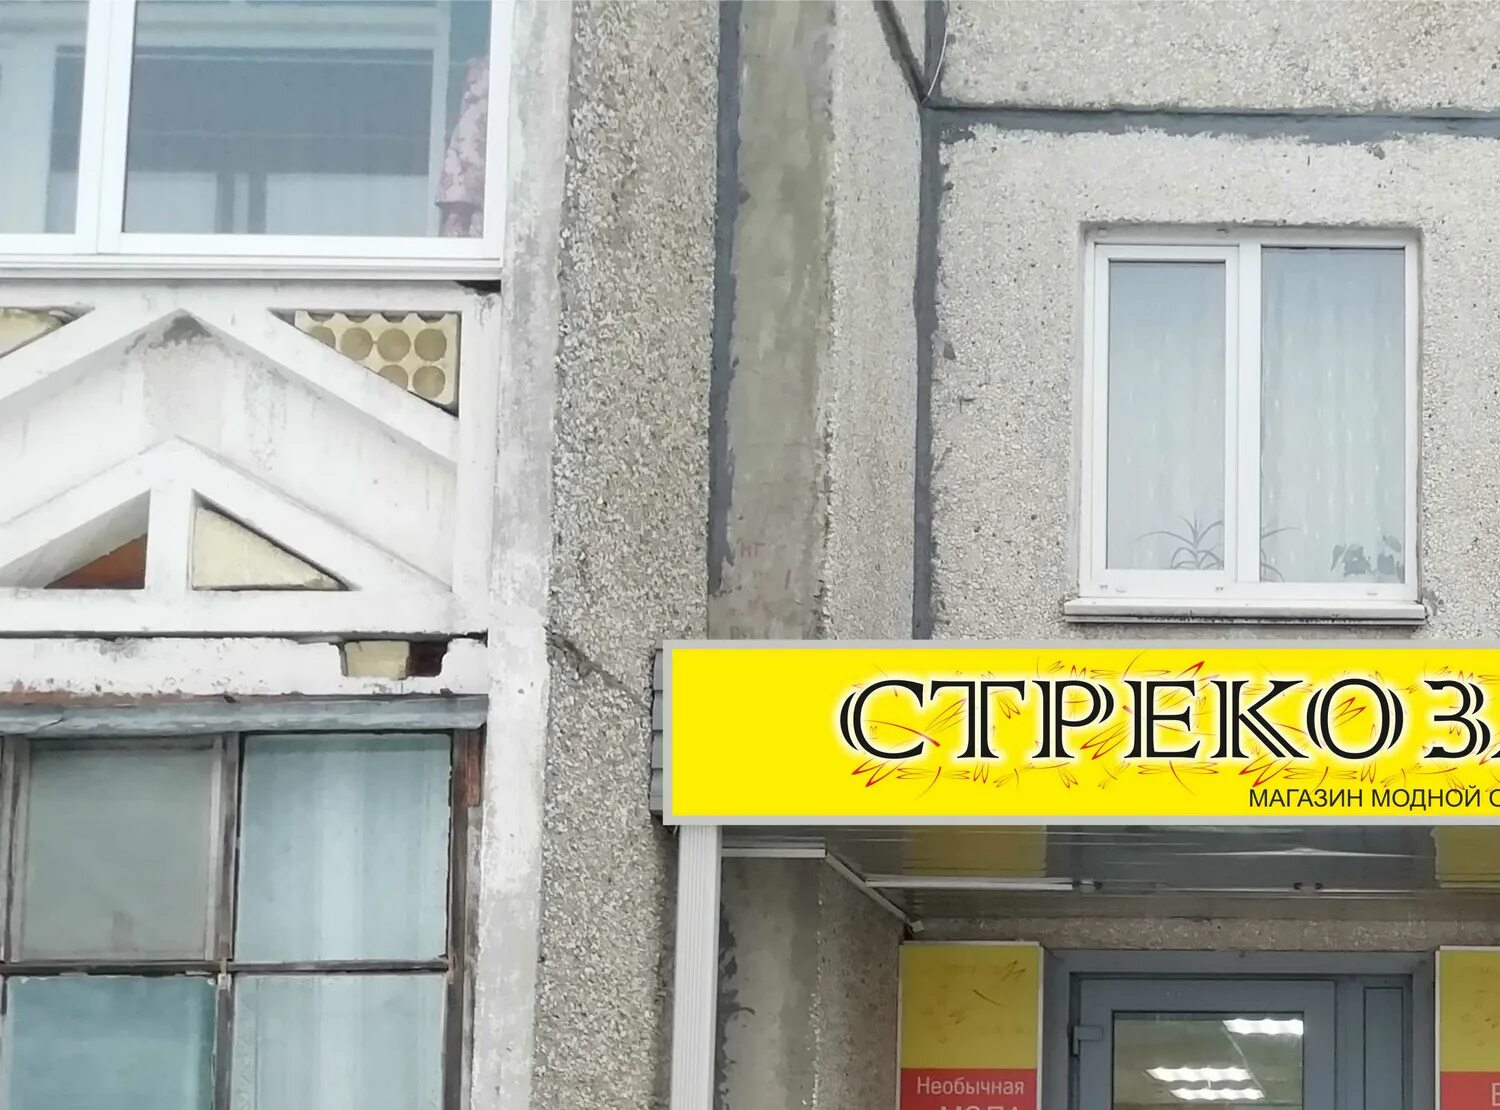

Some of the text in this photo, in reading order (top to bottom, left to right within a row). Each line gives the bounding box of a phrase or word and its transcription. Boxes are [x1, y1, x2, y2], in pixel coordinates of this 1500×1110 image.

[1248, 789, 1364, 808] МАГАЗИН
[1371, 785, 1482, 811] МОДНОЙ
[916, 1075, 1024, 1096] Необычная
